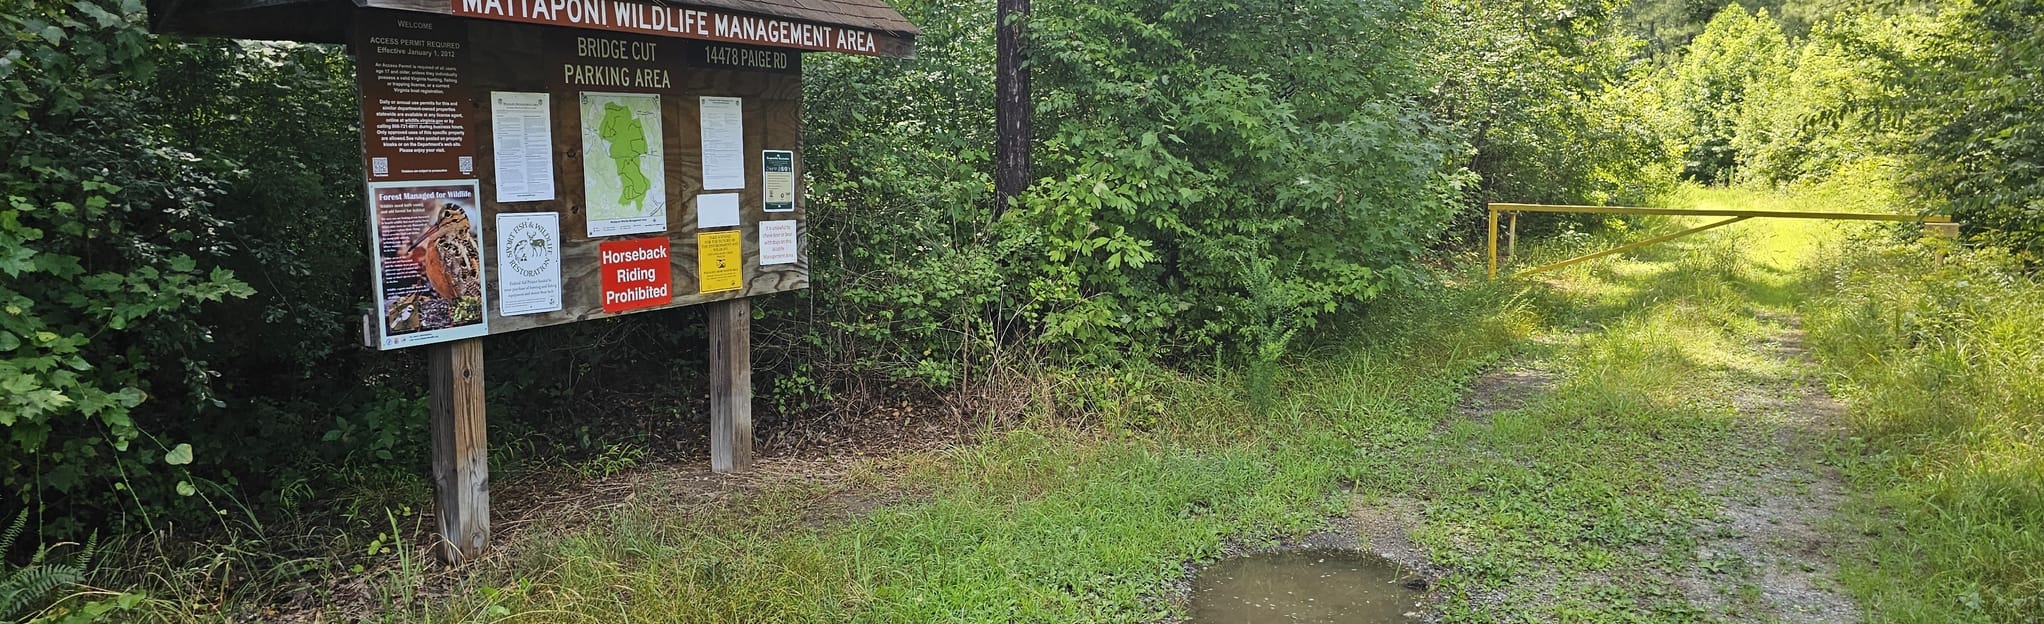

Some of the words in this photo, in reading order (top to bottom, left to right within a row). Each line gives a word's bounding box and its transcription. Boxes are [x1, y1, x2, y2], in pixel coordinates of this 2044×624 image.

[397, 19, 432, 30] WELCOME
[613, 1, 708, 35] WILDLIFE
[714, 13, 832, 48] MANAGEMENT
[836, 28, 876, 52] AREA
[370, 36, 399, 45] ACCESS
[400, 39, 425, 47] PERMIT
[426, 40, 460, 50] REQUIRED
[377, 46, 406, 54] Effective
[408, 48, 432, 58] January
[578, 36, 628, 60] BRIDGE
[632, 41, 657, 62] CUT
[704, 46, 738, 66] 14478
[741, 48, 772, 68] PAIGE
[773, 52, 787, 69] RD
[564, 64, 630, 87] PARKING
[635, 68, 671, 88] AREA
[379, 192, 402, 200] Forest
[404, 192, 434, 200] Managed
[447, 190, 472, 198] Wildlife
[513, 221, 528, 234] FISH
[535, 223, 553, 256] WILDLIFE
[602, 245, 667, 264] Horseback
[509, 257, 551, 278] RESTORATION
[616, 267, 656, 284] Riding
[606, 284, 668, 304] Prohibited
